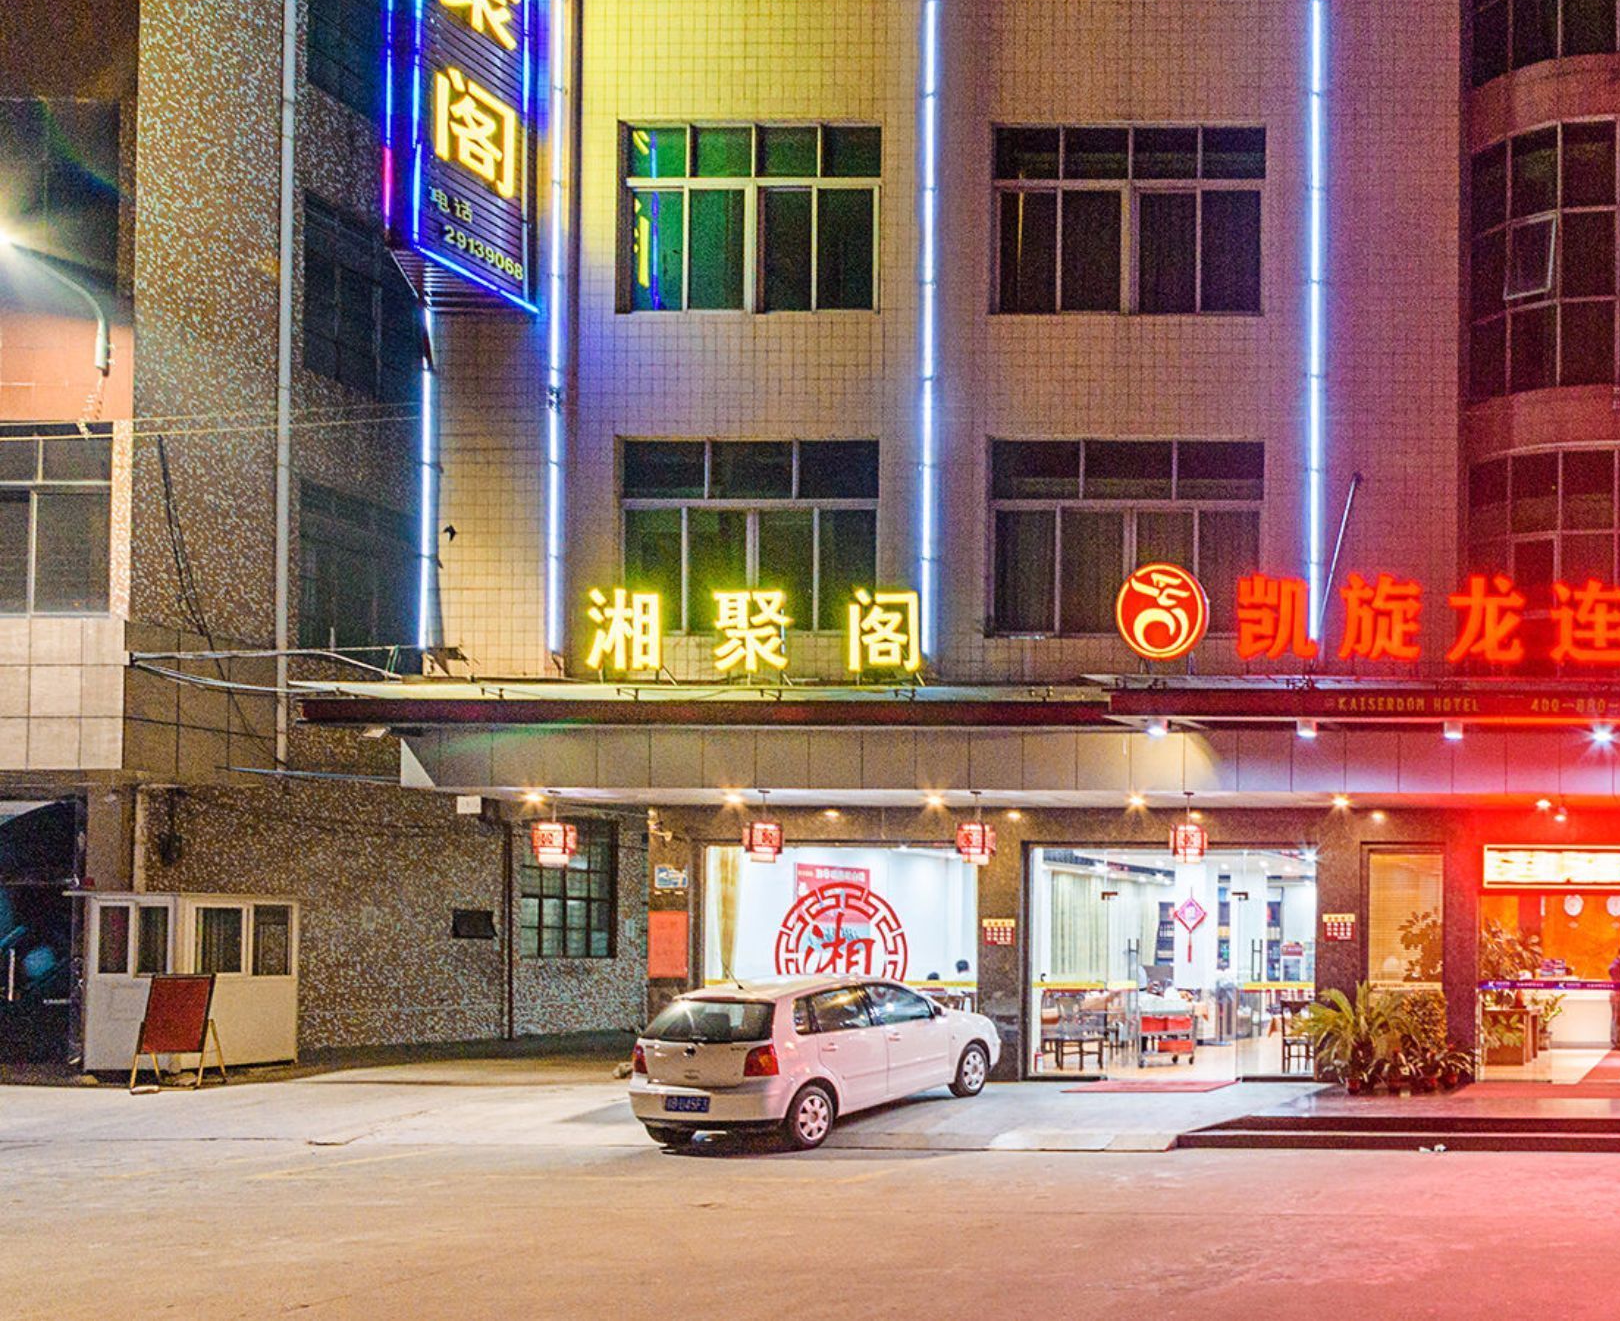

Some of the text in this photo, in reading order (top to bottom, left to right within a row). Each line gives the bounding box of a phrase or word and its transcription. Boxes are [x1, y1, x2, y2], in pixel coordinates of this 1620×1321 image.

[429, 187, 472, 224] 电话
[445, 225, 523, 280] 29139068
[584, 587, 923, 673] 湘聚阁
[1433, 697, 1480, 712] HOTEL
